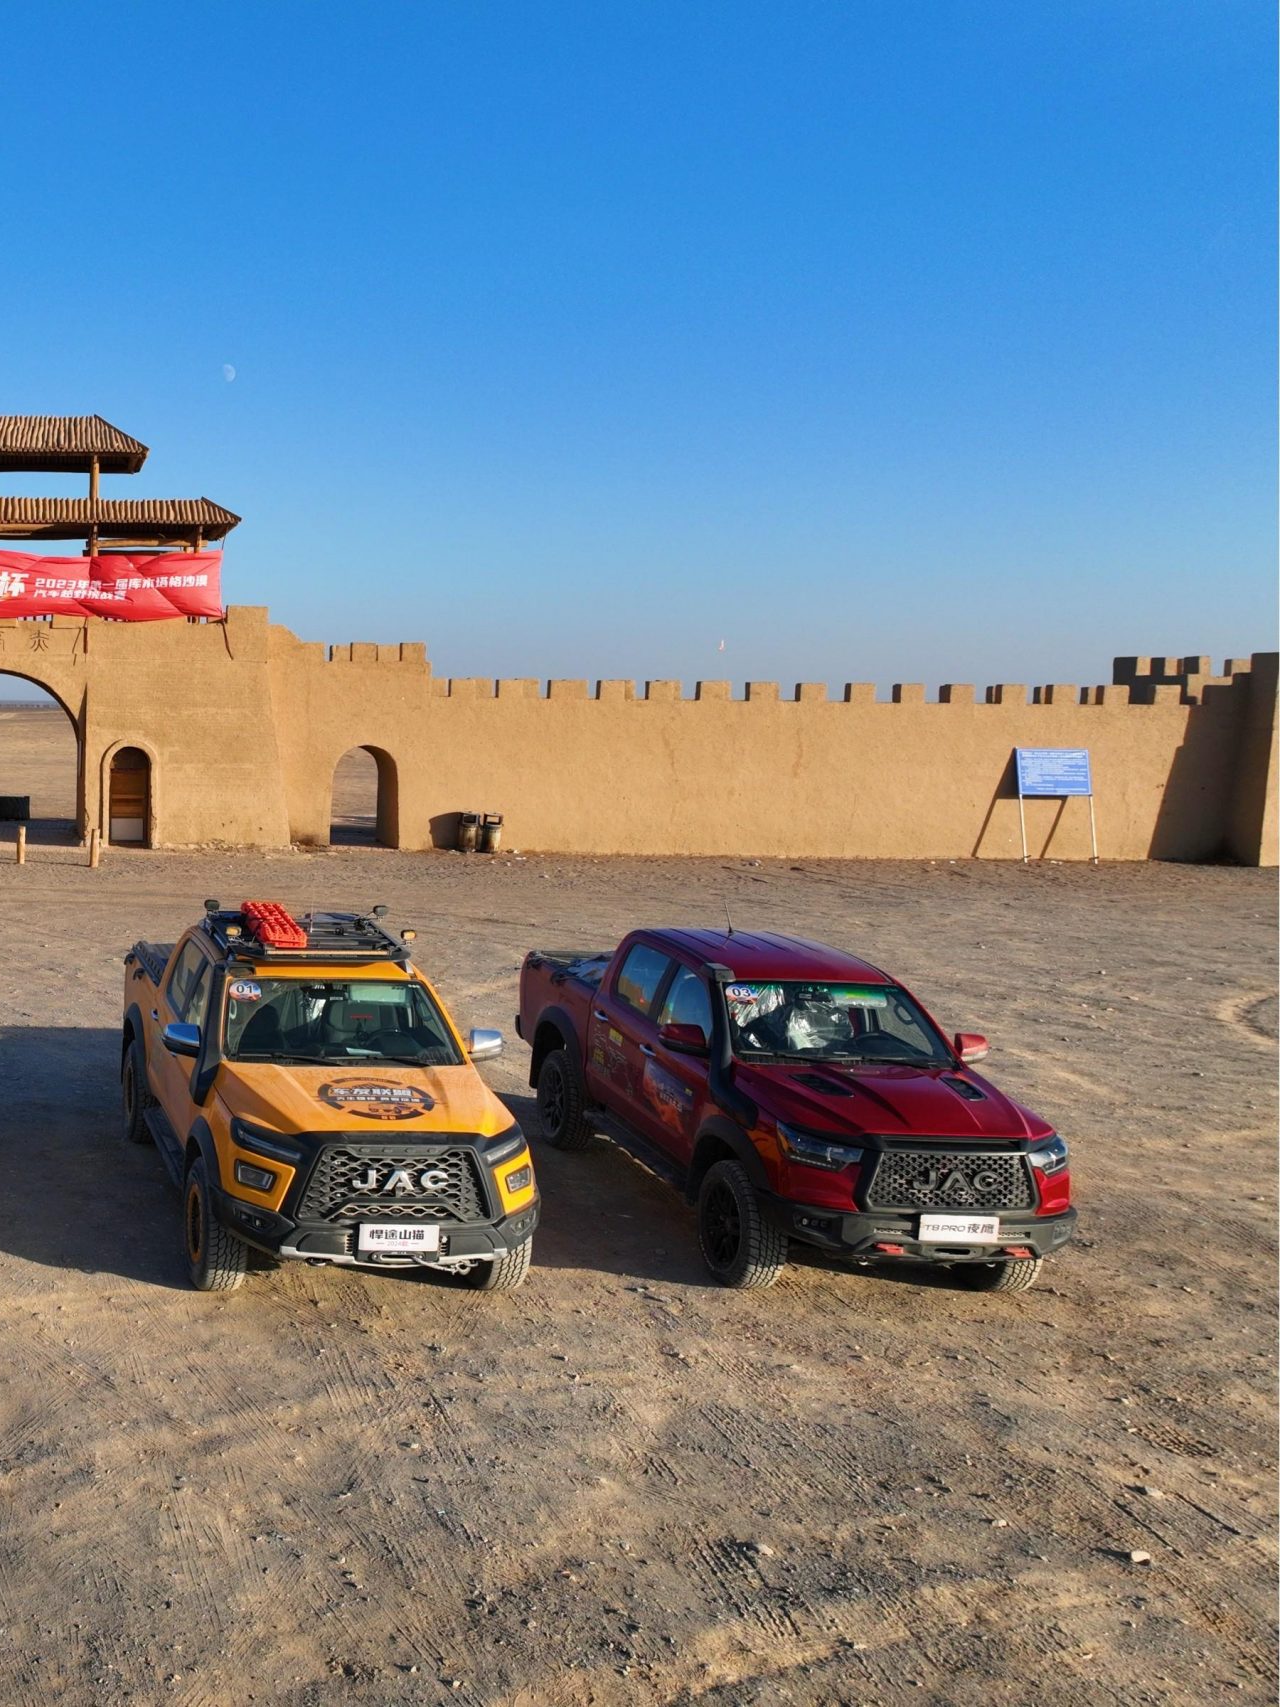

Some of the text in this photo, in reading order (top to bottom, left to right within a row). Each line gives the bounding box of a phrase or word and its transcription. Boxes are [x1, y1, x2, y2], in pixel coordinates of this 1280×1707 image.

[236, 984, 254, 994] 01
[732, 987, 751, 998] 03
[352, 1169, 449, 1191] JAC
[913, 1170, 999, 1192] JAC
[369, 1229, 425, 1240] 悍途山猫
